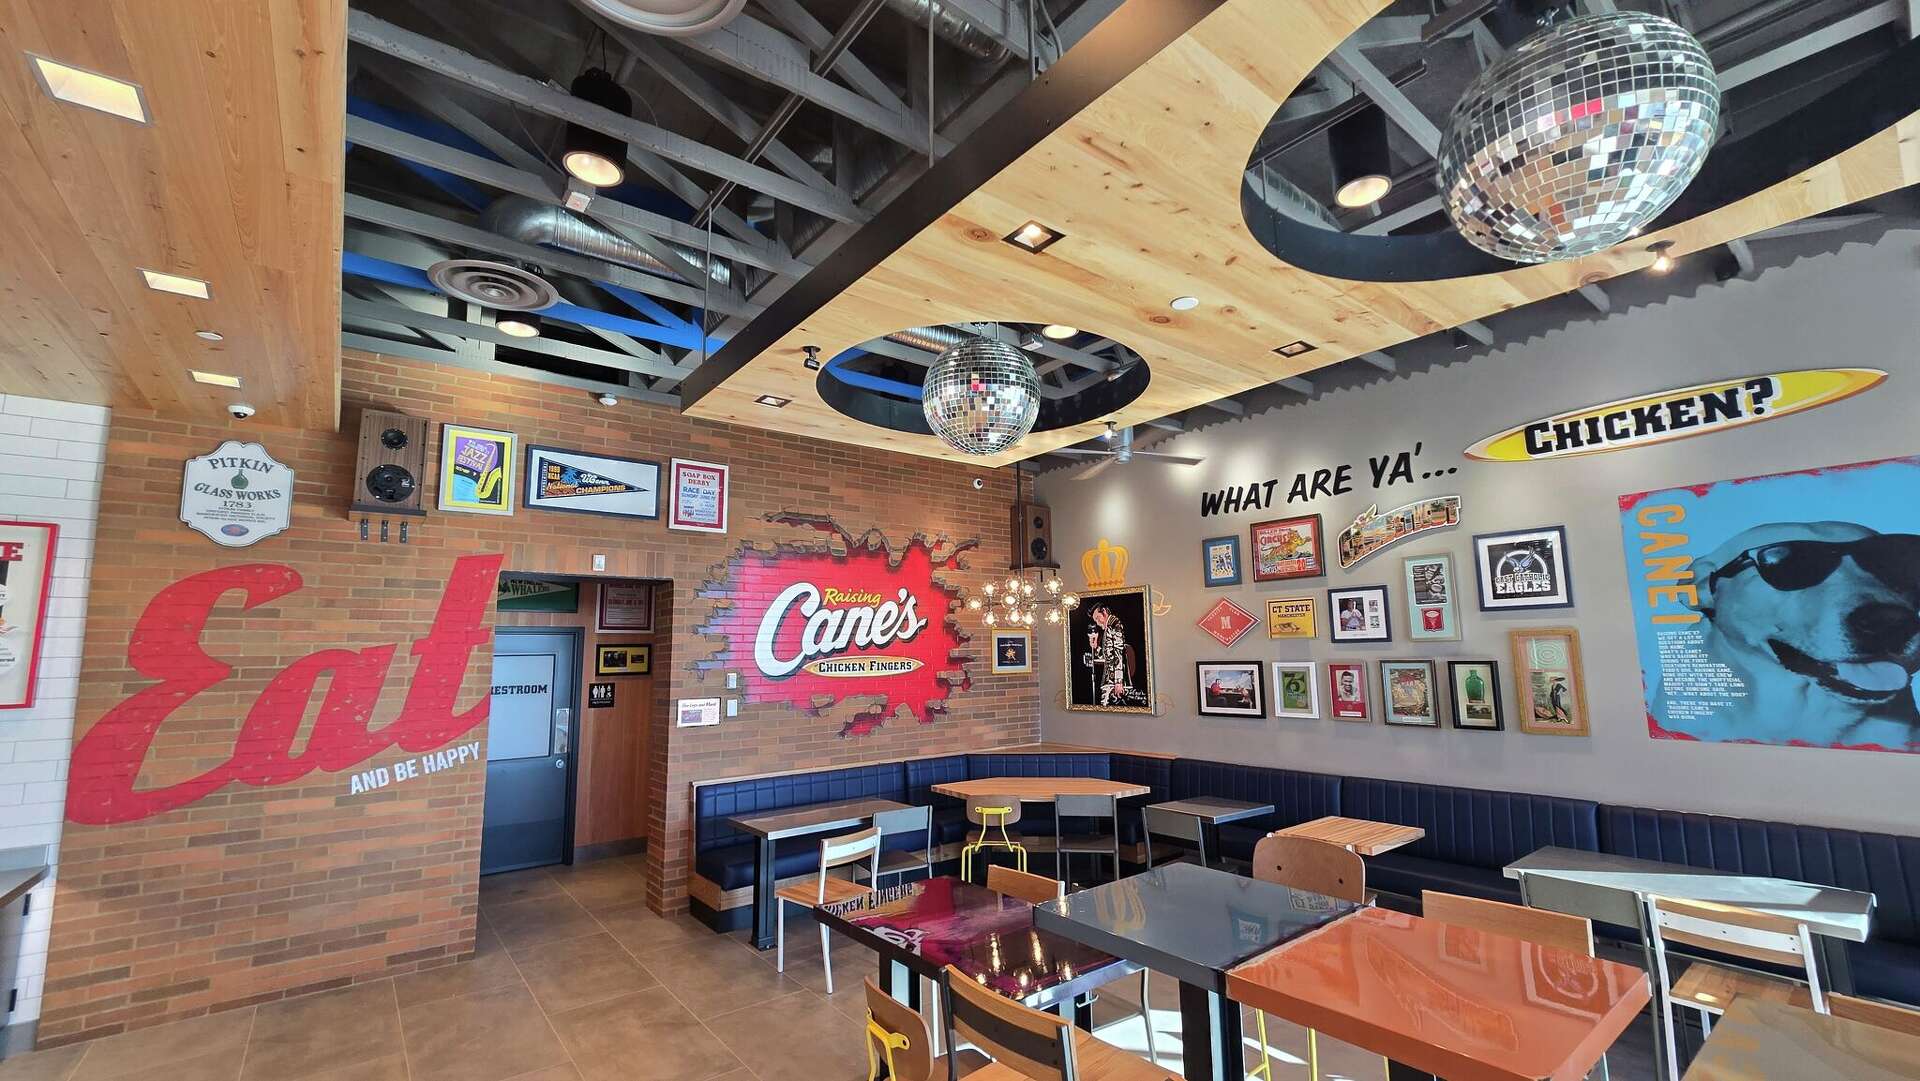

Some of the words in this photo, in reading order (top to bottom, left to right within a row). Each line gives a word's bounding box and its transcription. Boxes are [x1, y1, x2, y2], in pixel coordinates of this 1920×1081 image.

[1524, 377, 1774, 455] CHICKEN?
[461, 446, 488, 463] JAZZ
[207, 457, 275, 473] PITKIN
[681, 471, 701, 479] SOAP
[687, 478, 711, 486] DERBY
[194, 483, 233, 498] GLASS
[235, 489, 281, 500] WORKS
[575, 485, 626, 494] CHAMPIONS
[682, 486, 700, 494] RACE
[1201, 479, 1278, 517] WHAT
[1287, 465, 1353, 504] ARE
[223, 501, 252, 509] 1783
[1637, 503, 1698, 608] CANE
[1495, 574, 1514, 583] EAST
[1514, 572, 1551, 581] CATHOLIC
[1495, 581, 1551, 594] EAGLES
[823, 588, 882, 607] Raising
[1272, 605, 1284, 613] CT
[1284, 604, 1311, 613] STATE
[754, 582, 927, 677] Cane's
[1220, 615, 1232, 629] M
[818, 661, 866, 674] CHICKEN
[869, 660, 912, 672] FINGERS
[65, 553, 504, 824] Eat
[351, 767, 390, 795] AND
[394, 758, 419, 782] BE
[422, 741, 479, 774] HAPPY
